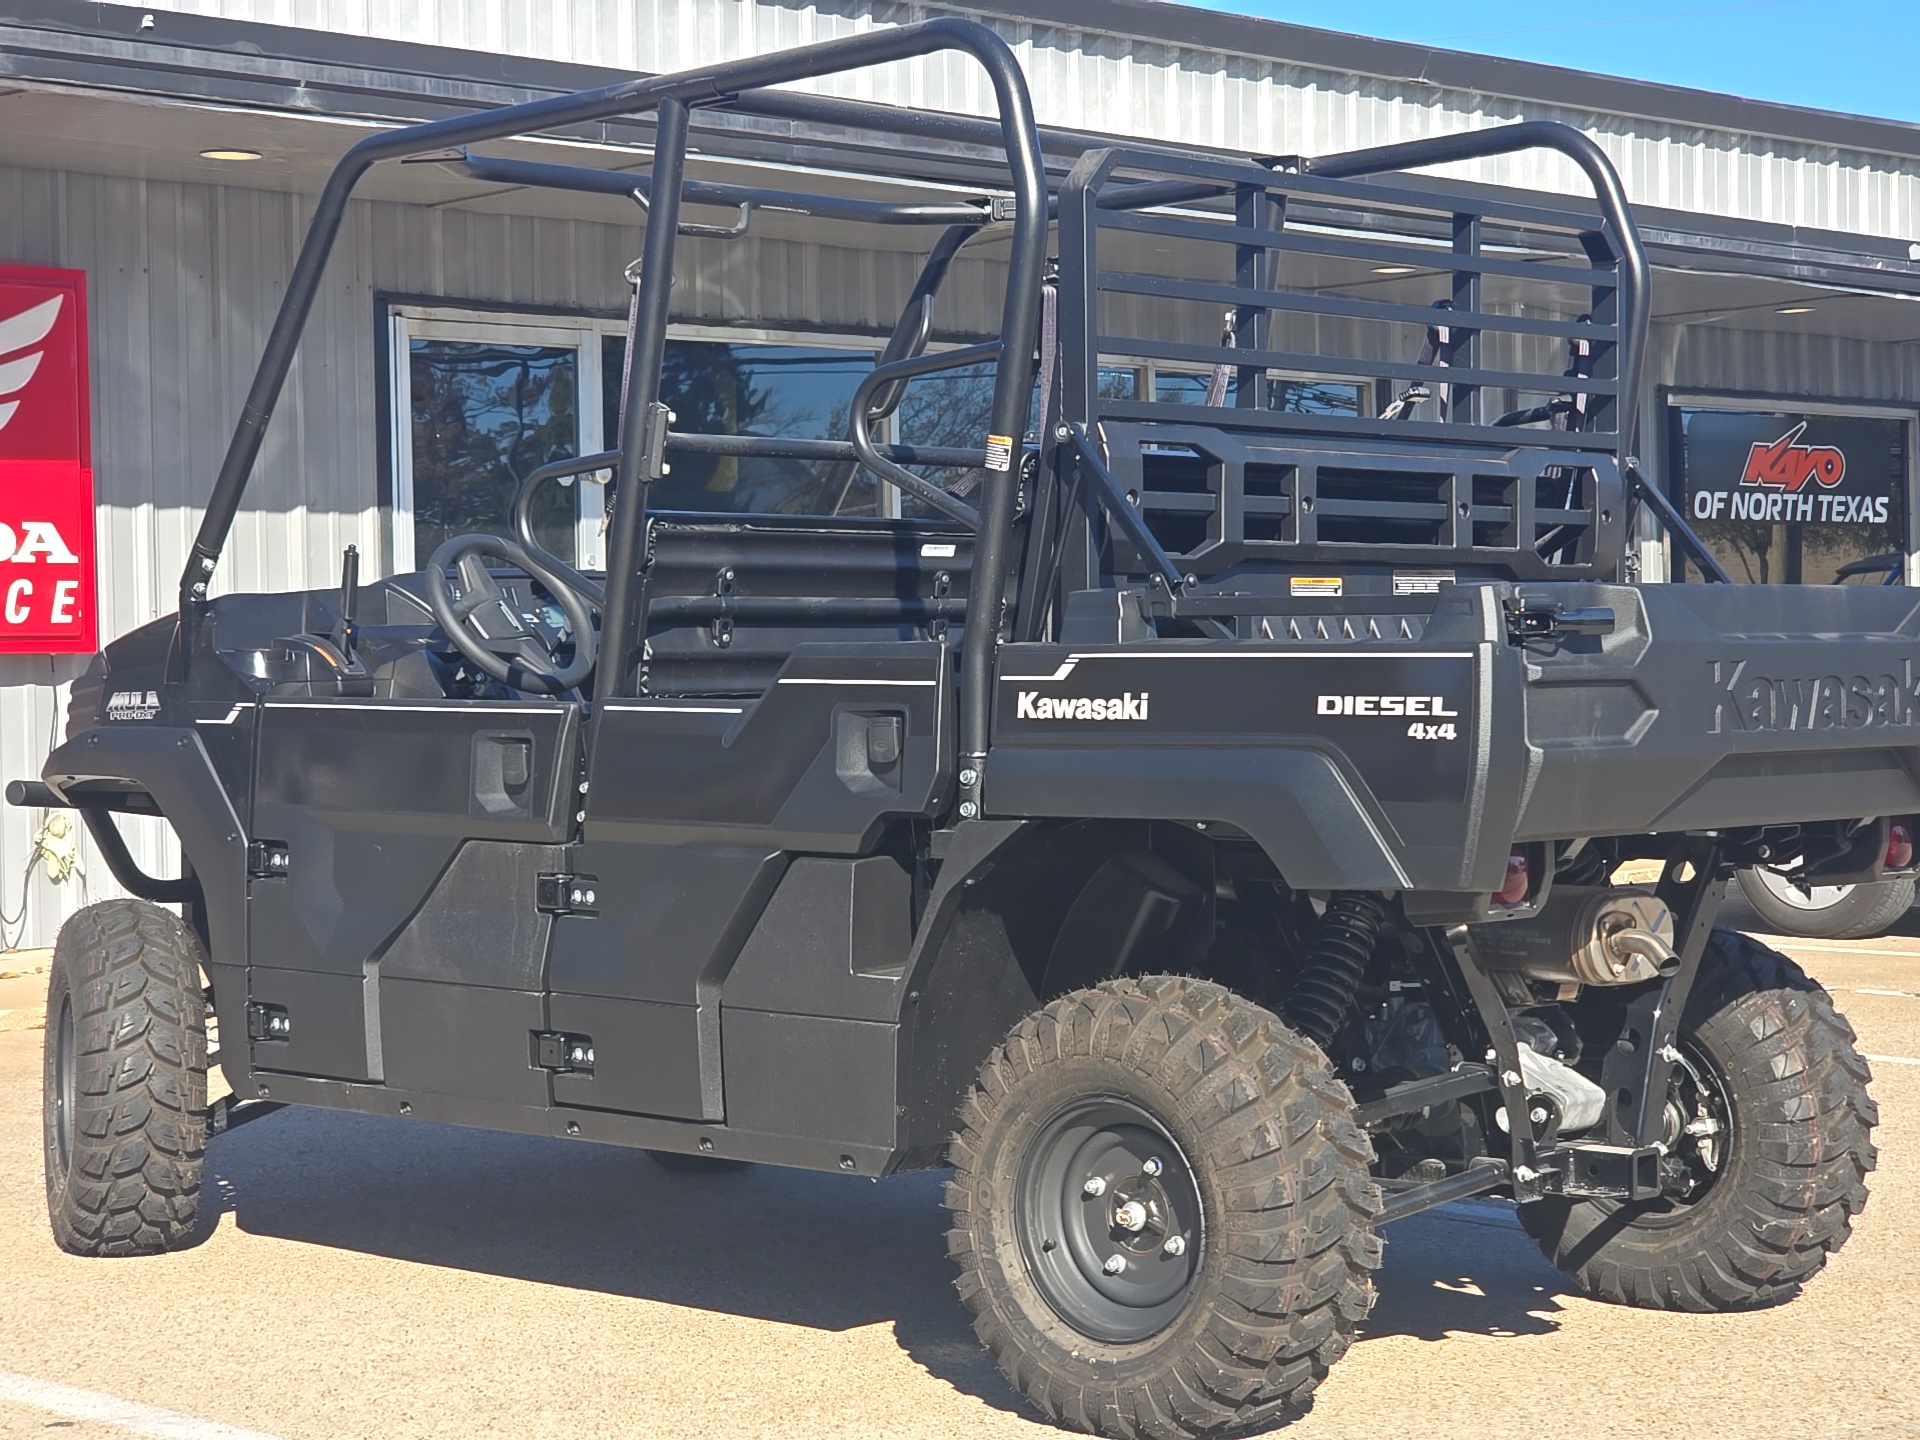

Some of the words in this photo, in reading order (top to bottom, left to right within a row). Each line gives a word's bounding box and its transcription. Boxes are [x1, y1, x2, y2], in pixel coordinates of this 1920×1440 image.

[1694, 491, 1728, 520] OF
[1731, 492, 1815, 522] NORTH
[1818, 495, 1889, 523] TEXAS
[1017, 691, 1149, 720] Kawasaki
[1317, 695, 1458, 716] DIESEL
[1407, 722, 1457, 740] 4x4
